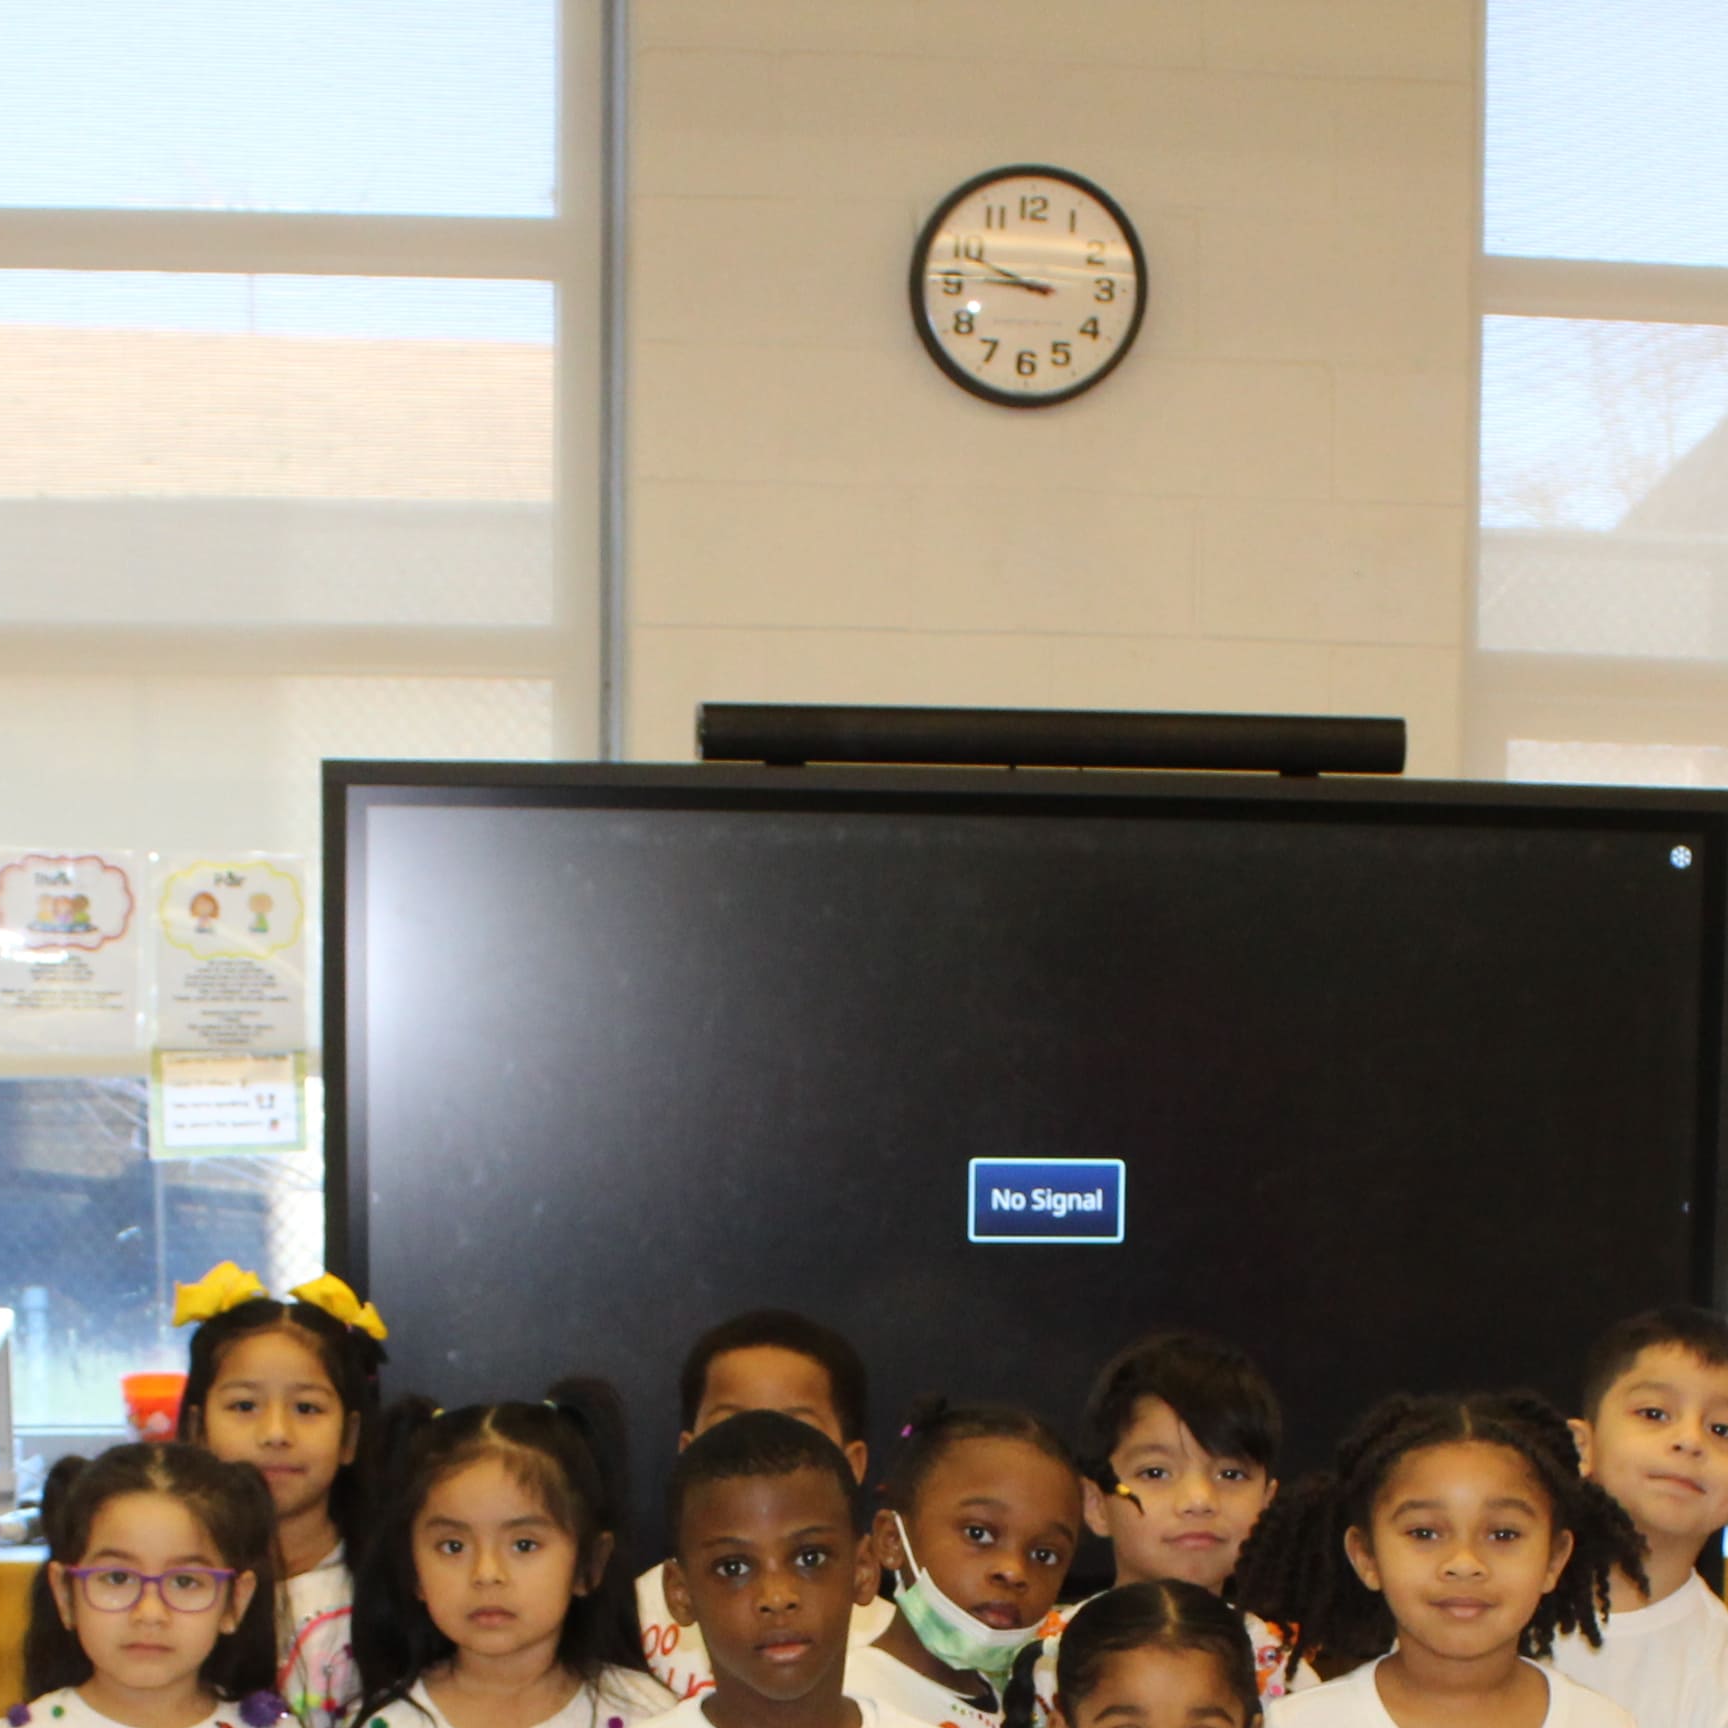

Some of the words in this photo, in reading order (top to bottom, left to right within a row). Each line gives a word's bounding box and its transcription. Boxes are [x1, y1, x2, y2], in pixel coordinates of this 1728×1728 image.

[986, 206, 1006, 230] 11
[1020, 196, 1048, 221] 12
[1069, 210, 1075, 232] 1
[953, 236, 983, 259] 10
[1086, 241, 1105, 265] 2
[943, 271, 963, 296] 9
[1094, 280, 1115, 302] 3
[954, 311, 974, 335] 8
[1080, 318, 1099, 340] 4
[980, 338, 999, 363] 7
[1052, 342, 1071, 366] 5
[1016, 352, 1037, 376] 6
[991, 1189, 1026, 1210] No
[1031, 1188, 1102, 1218] Signal
